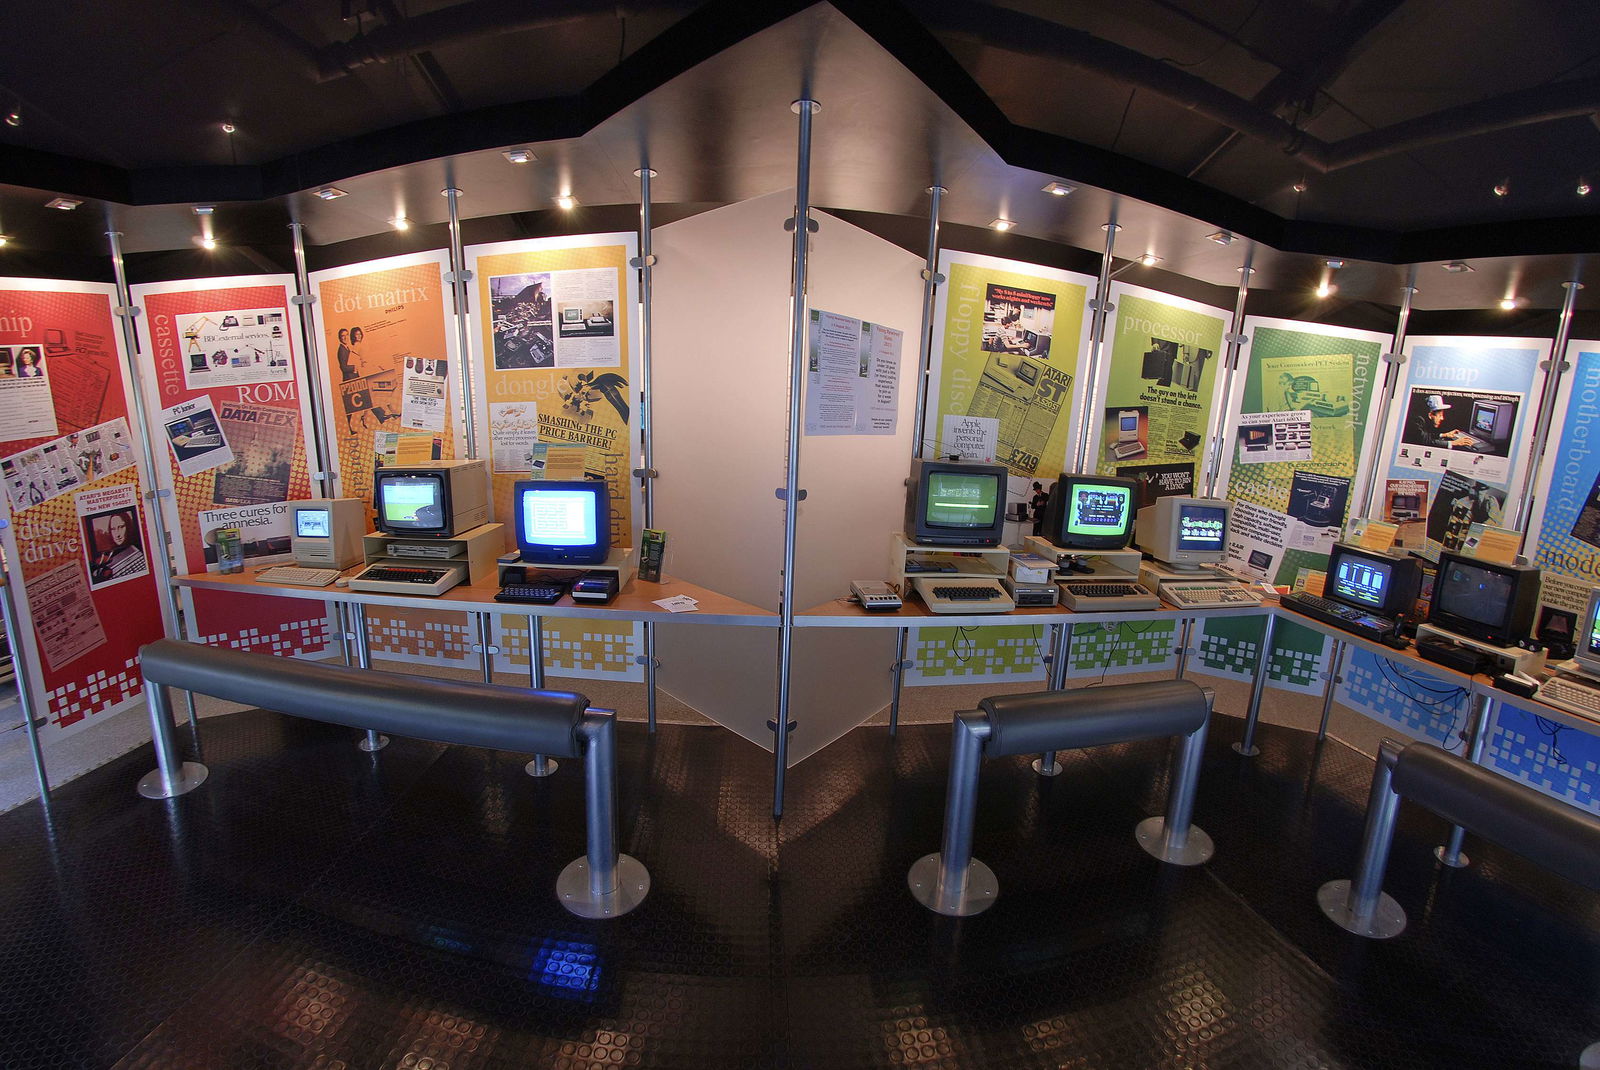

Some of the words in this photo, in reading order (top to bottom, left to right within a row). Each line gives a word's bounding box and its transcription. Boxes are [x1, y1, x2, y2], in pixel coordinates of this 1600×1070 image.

[334, 294, 363, 313] dot
[367, 282, 429, 309] matrix
[950, 284, 980, 360] floppy
[1123, 316, 1203, 345] processor
[204, 335, 216, 343] BBC
[218, 333, 244, 342] external
[154, 315, 180, 396] cassette
[1043, 367, 1071, 387] ATARI
[1415, 360, 1481, 386] bitmap
[236, 381, 297, 404] ROM
[495, 374, 567, 400] dongle
[950, 368, 972, 413] disc
[1037, 379, 1067, 402] ST
[1147, 386, 1157, 394] The
[1158, 389, 1168, 397] guy
[1178, 391, 1187, 399] the
[1345, 353, 1371, 430] network
[172, 407, 181, 415] PC
[181, 403, 196, 413] Junior
[352, 392, 363, 407] C
[1140, 393, 1160, 403] doesn't
[1161, 397, 1177, 405] stand
[221, 408, 296, 427] DATAFLEX
[538, 413, 582, 430] SMASHING
[584, 423, 604, 435] THE
[605, 428, 618, 439] PC
[961, 418, 981, 429] Apple
[540, 425, 567, 439] PRICE
[568, 430, 613, 450] BARRIER!
[954, 426, 975, 435] invents
[977, 428, 987, 437] the
[956, 435, 984, 443] personal
[1557, 367, 1600, 515] motherboard
[1010, 448, 1039, 470] £749
[344, 437, 370, 503] portabl
[604, 452, 624, 499] hard
[79, 492, 101, 501] ATARI'S
[102, 486, 132, 497] MEGABYTE
[1235, 480, 1287, 498] cache
[204, 511, 238, 523] Three
[239, 507, 271, 517] cures
[272, 503, 288, 515] for
[1233, 512, 1243, 520] high
[1263, 522, 1282, 532] software
[1235, 507, 1255, 517] choosing
[1245, 504, 1257, 512] those
[1268, 511, 1286, 522] thought
[20, 515, 64, 540] disc
[222, 516, 273, 529] amnesia.
[610, 508, 626, 549] driv
[1230, 521, 1248, 530] usiness
[1248, 528, 1270, 539] computer
[1250, 534, 1263, 542] white
[24, 536, 79, 563] drive
[44, 579, 82, 601] SPECTRUM
[1545, 576, 1563, 587] Before
[1575, 584, 1591, 593] comp
[1541, 597, 1559, 605] double
[1542, 591, 1561, 599] system
